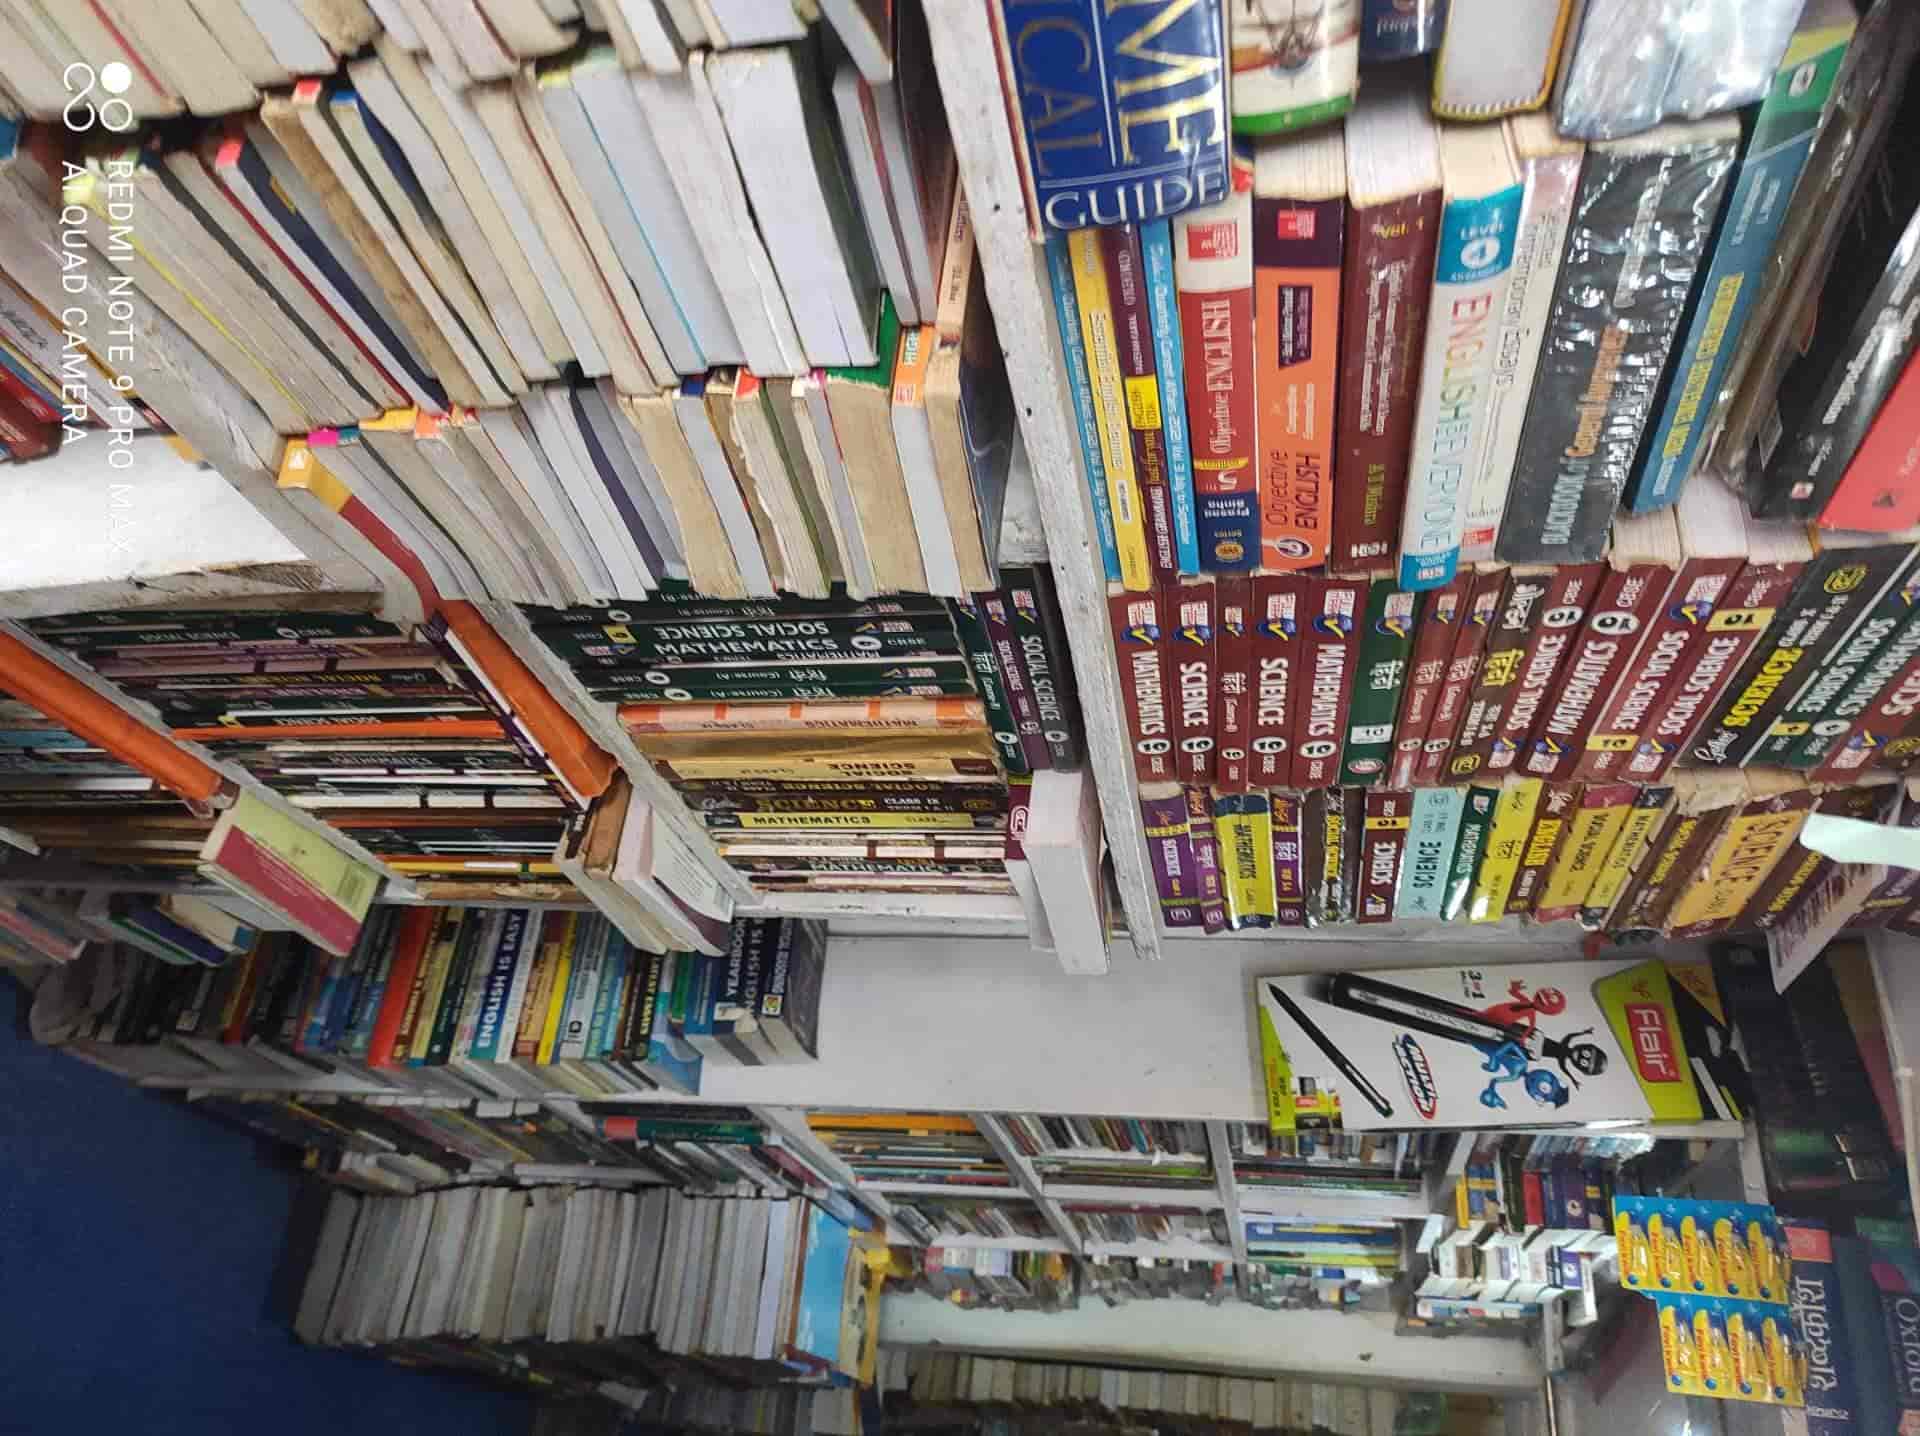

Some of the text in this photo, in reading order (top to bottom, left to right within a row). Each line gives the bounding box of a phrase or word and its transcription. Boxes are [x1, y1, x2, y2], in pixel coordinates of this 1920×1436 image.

[1044, 169, 1225, 231] GUIDE
[1201, 299, 1236, 455] Objective ENGLISH
[1438, 292, 1494, 424] ENGLISH
[1265, 448, 1291, 528] Objective
[1293, 453, 1321, 530] ENGLISH
[1540, 474, 1587, 546] BLACKBOOK
[653, 623, 745, 640] SCIENCE
[653, 637, 840, 658] MATHEMATICS
[748, 620, 830, 637] SOCIAL
[1639, 629, 1691, 680] SOCIAL
[1019, 634, 1062, 722] SOCIAL SCIENCE
[1306, 643, 1347, 737] MATHEMATICS
[1368, 659, 1404, 690] हिंदी
[1480, 648, 1525, 688] हिंदी
[1523, 631, 1568, 689] SCIENCE
[1546, 639, 1619, 736] MATHEMATICS
[1657, 692, 1704, 736] SOCIAL
[1683, 636, 1740, 693] SCIENCE
[1721, 647, 1804, 728] SCIENCE
[1797, 617, 1897, 713] SOCIAL SCIENCE
[1131, 649, 1166, 736] MATHEMATICS
[1179, 661, 1209, 728] SCIENCE
[1257, 657, 1289, 727] SCIENCE
[1506, 687, 1545, 731] SOCIAL
[1612, 679, 1661, 730] SCIENCE
[827, 762, 915, 770] SCIENCE
[753, 816, 871, 825] MATHEMATICS
[1455, 822, 1483, 875] MATHEMATICS
[810, 863, 950, 873] MATHEMATICS
[1233, 824, 1257, 880] MATHEMATICS
[1370, 840, 1397, 886] SCIENCE
[1412, 840, 1442, 889] SCIENCE
[477, 913, 521, 1049] ENGLISH IS EASY
[743, 947, 761, 1011] NGLISH
[1468, 970, 1483, 982] 3
[1471, 991, 1486, 1000] 1
[1631, 1007, 1668, 1076] Flair
[1791, 1275, 1838, 1391] शब्दकोश
